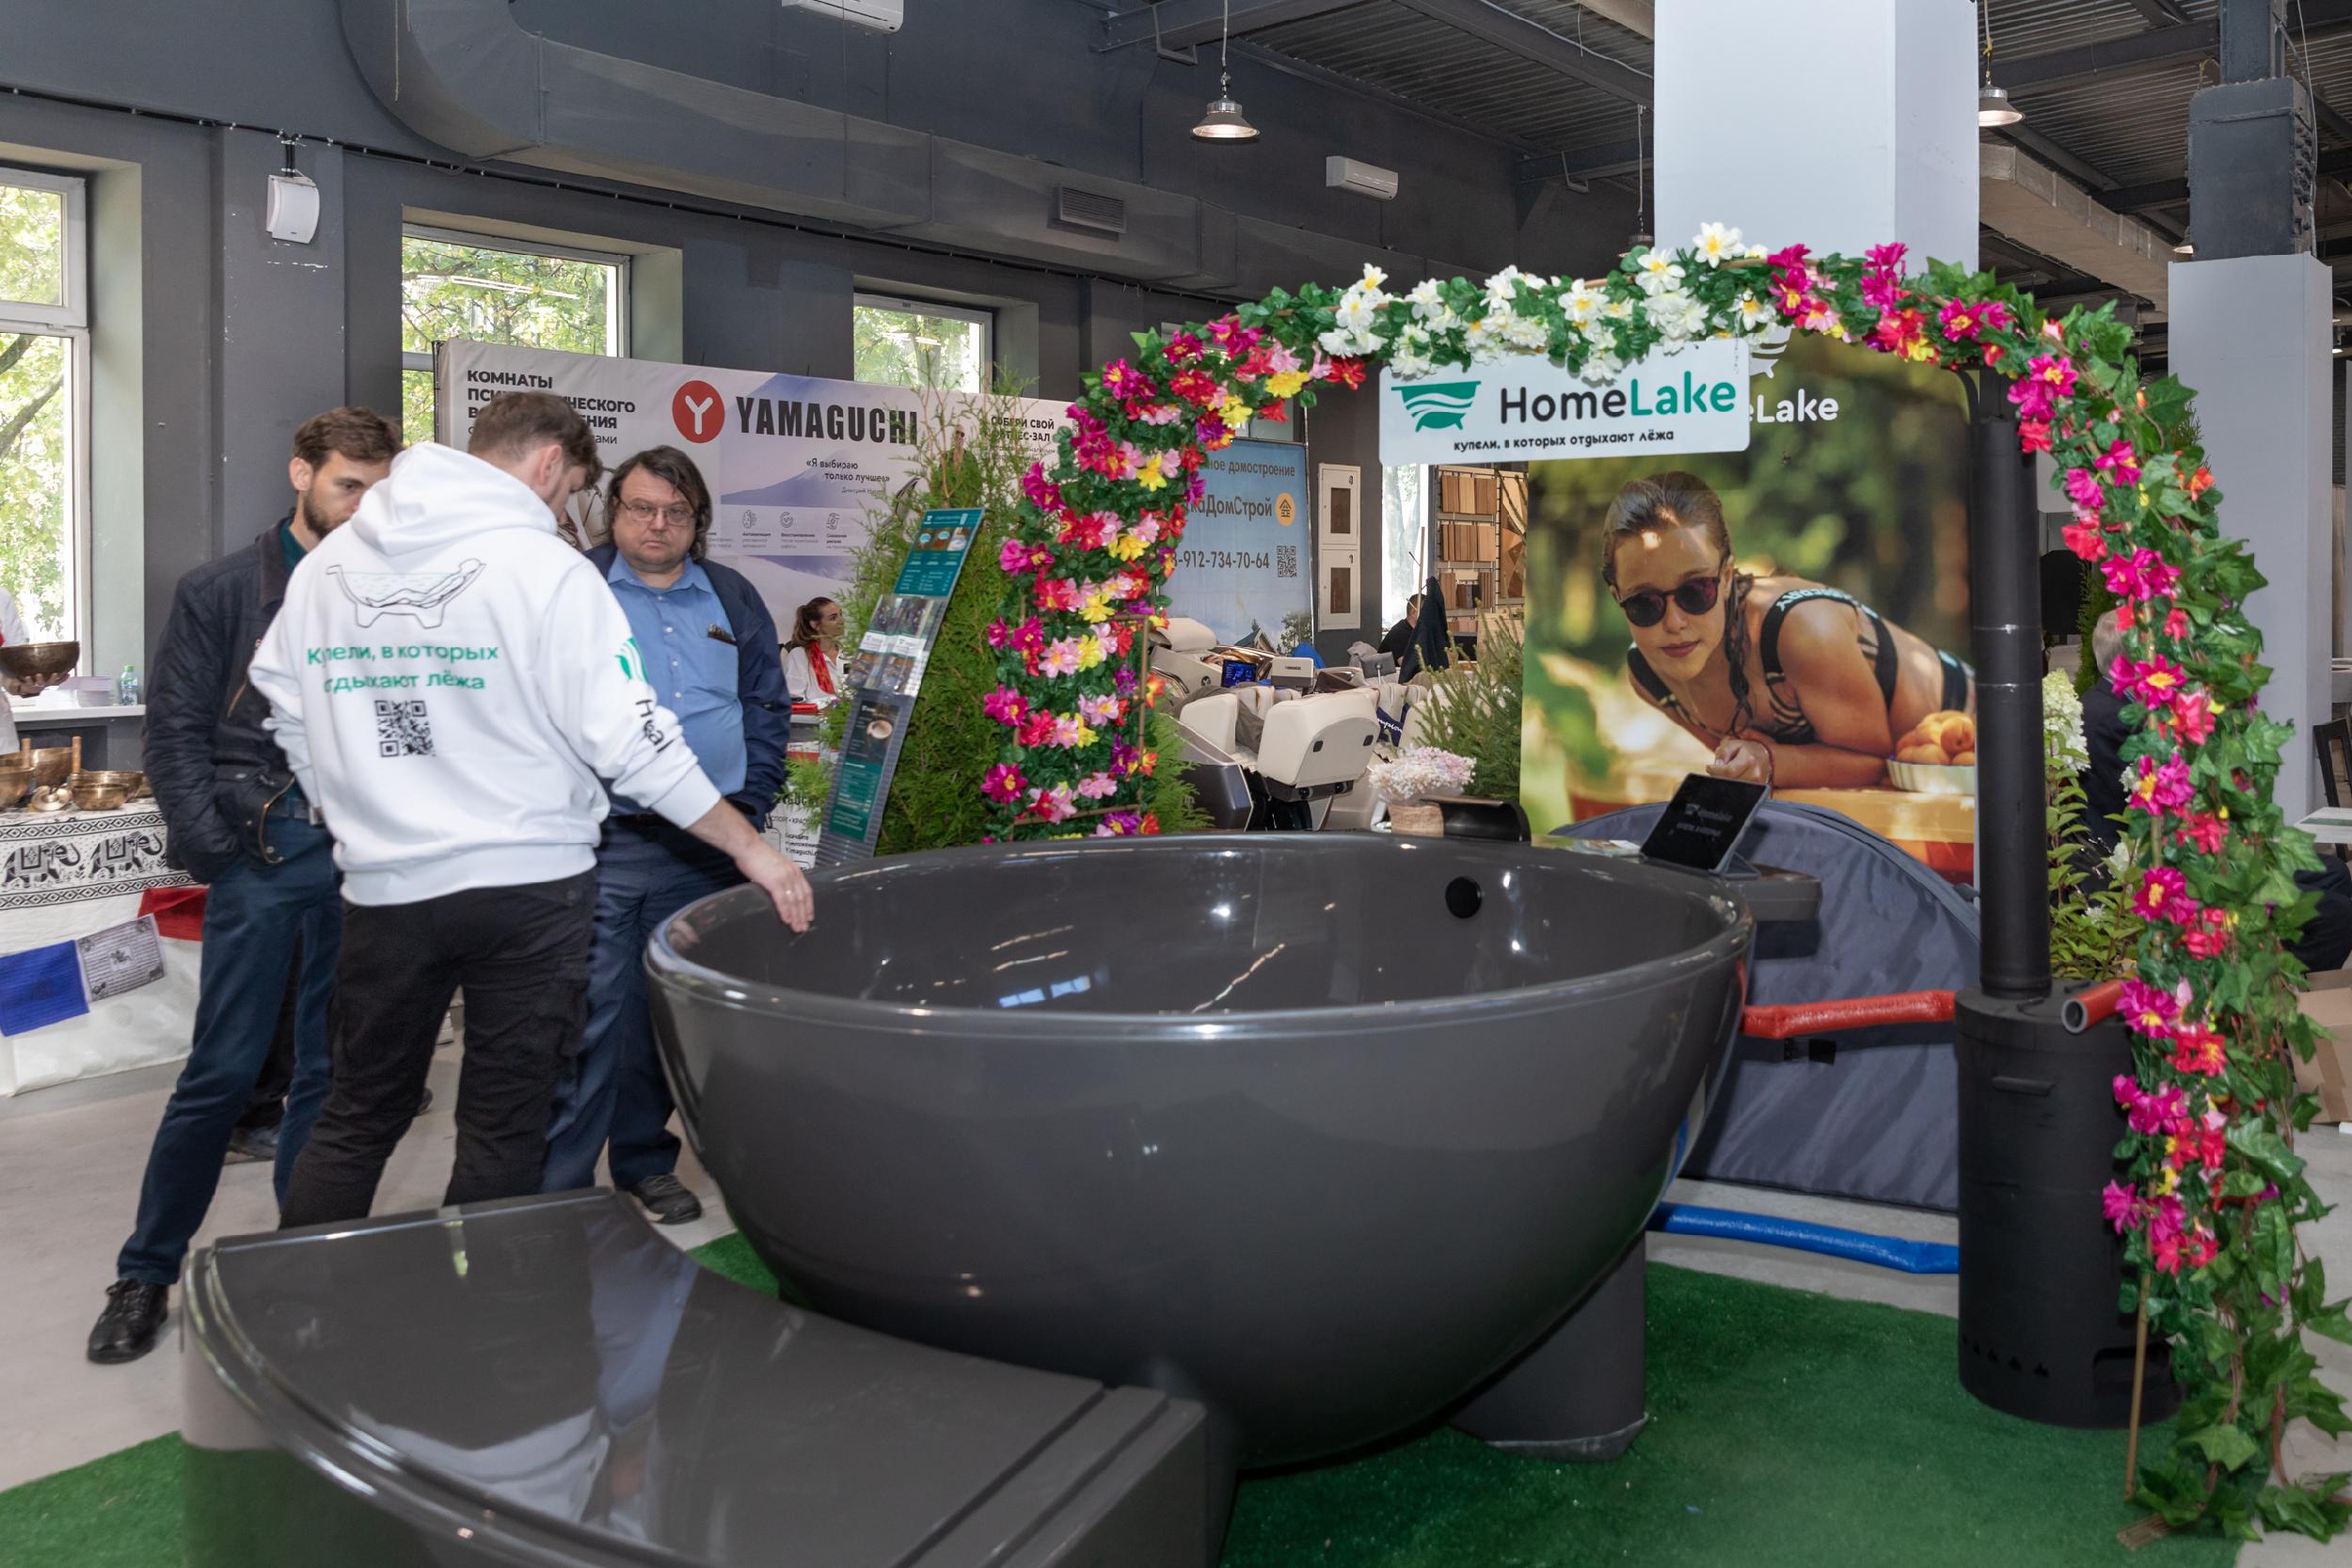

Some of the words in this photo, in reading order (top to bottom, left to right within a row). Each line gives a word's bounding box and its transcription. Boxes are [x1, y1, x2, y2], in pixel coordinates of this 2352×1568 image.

[468, 370, 552, 388] КОМНАТЫ
[1501, 371, 1737, 424] HomeLake
[1749, 388, 1839, 423] Lake
[736, 396, 917, 445] YAMAGUCHI
[1030, 418, 1055, 430] СВОЙ
[1513, 436, 1565, 451] которых
[1570, 431, 1634, 448] отдыхают
[1639, 429, 1675, 442] лёжа
[819, 459, 859, 470] выбираю
[1229, 460, 1295, 478] домостроение
[825, 472, 854, 482] только
[398, 644, 499, 663] которых
[426, 670, 485, 690] лёжа
